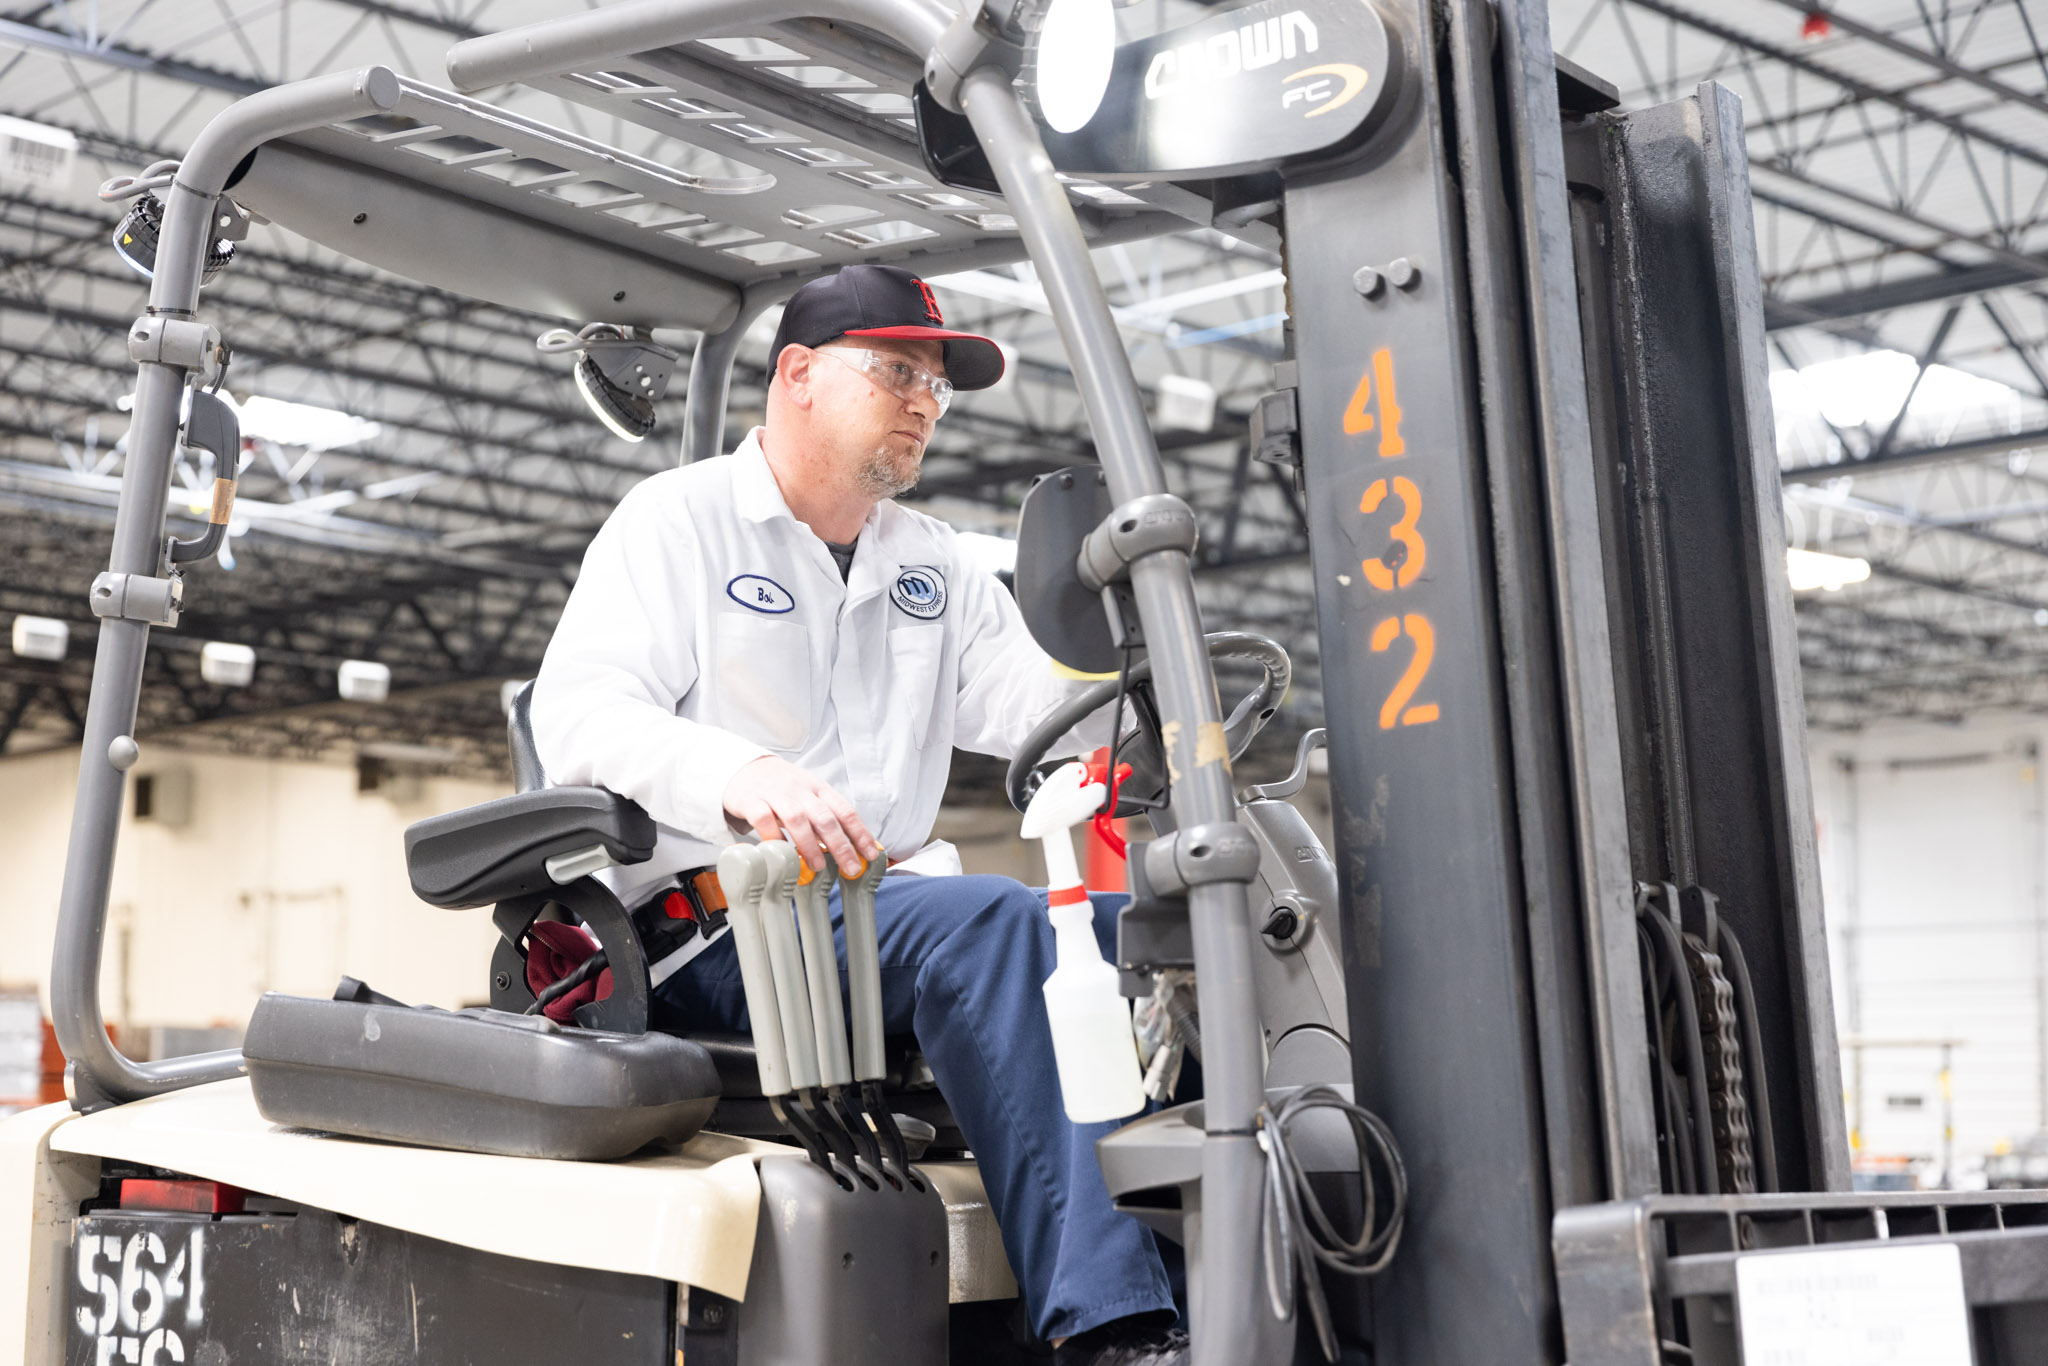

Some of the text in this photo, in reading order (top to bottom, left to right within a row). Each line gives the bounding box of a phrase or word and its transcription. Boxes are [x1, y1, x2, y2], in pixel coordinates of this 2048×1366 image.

[1282, 79, 1332, 109] FC
[897, 590, 943, 613] MIDWEST EXPRESS
[76, 1228, 205, 1336] 564
